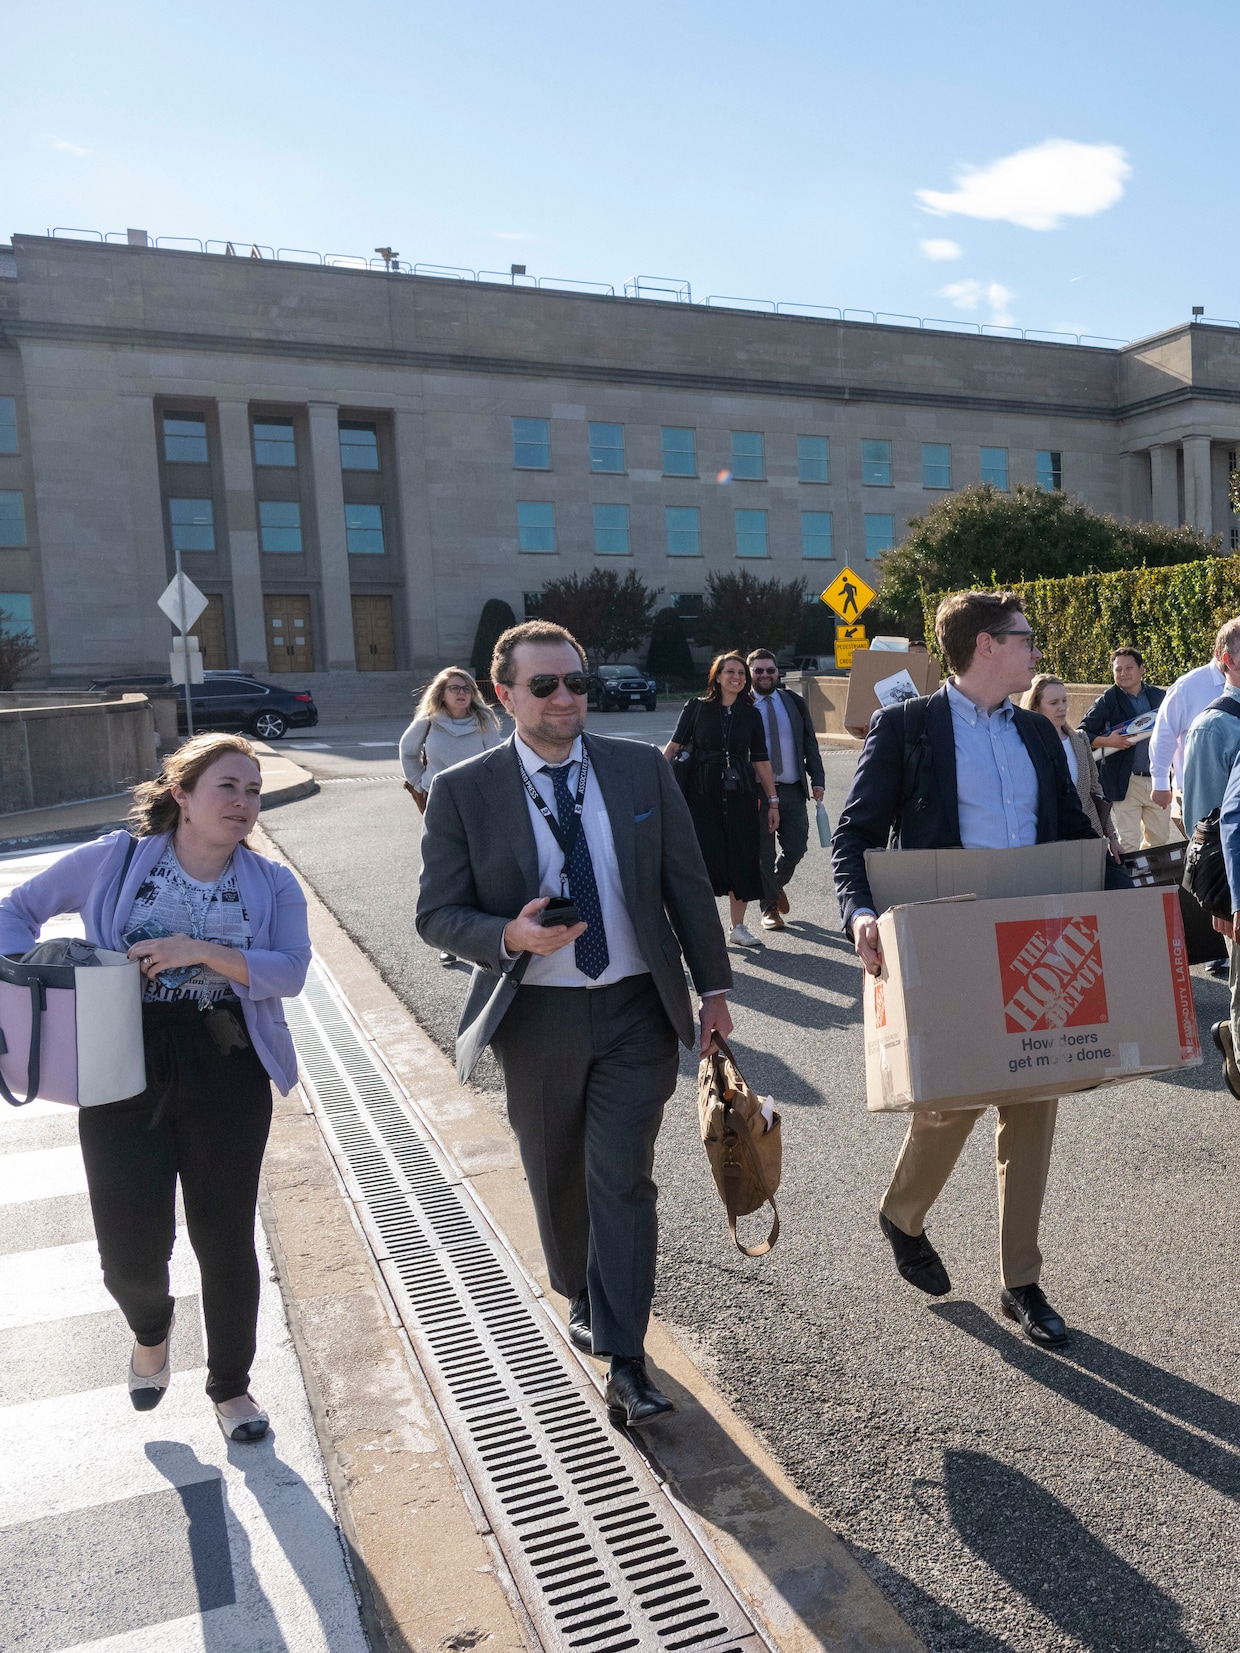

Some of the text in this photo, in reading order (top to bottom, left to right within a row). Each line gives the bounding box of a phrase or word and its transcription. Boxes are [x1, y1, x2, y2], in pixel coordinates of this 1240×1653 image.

[525, 782, 539, 800] PRESS
[578, 758, 588, 795] ASSOCIATED
[1009, 930, 1051, 976] THE
[1173, 938, 1186, 982] LARGE
[1004, 916, 1100, 1032] HOME
[1046, 955, 1103, 1029] DEPOT
[1022, 1033, 1098, 1051] How doers
[1008, 1055, 1032, 1073] get
